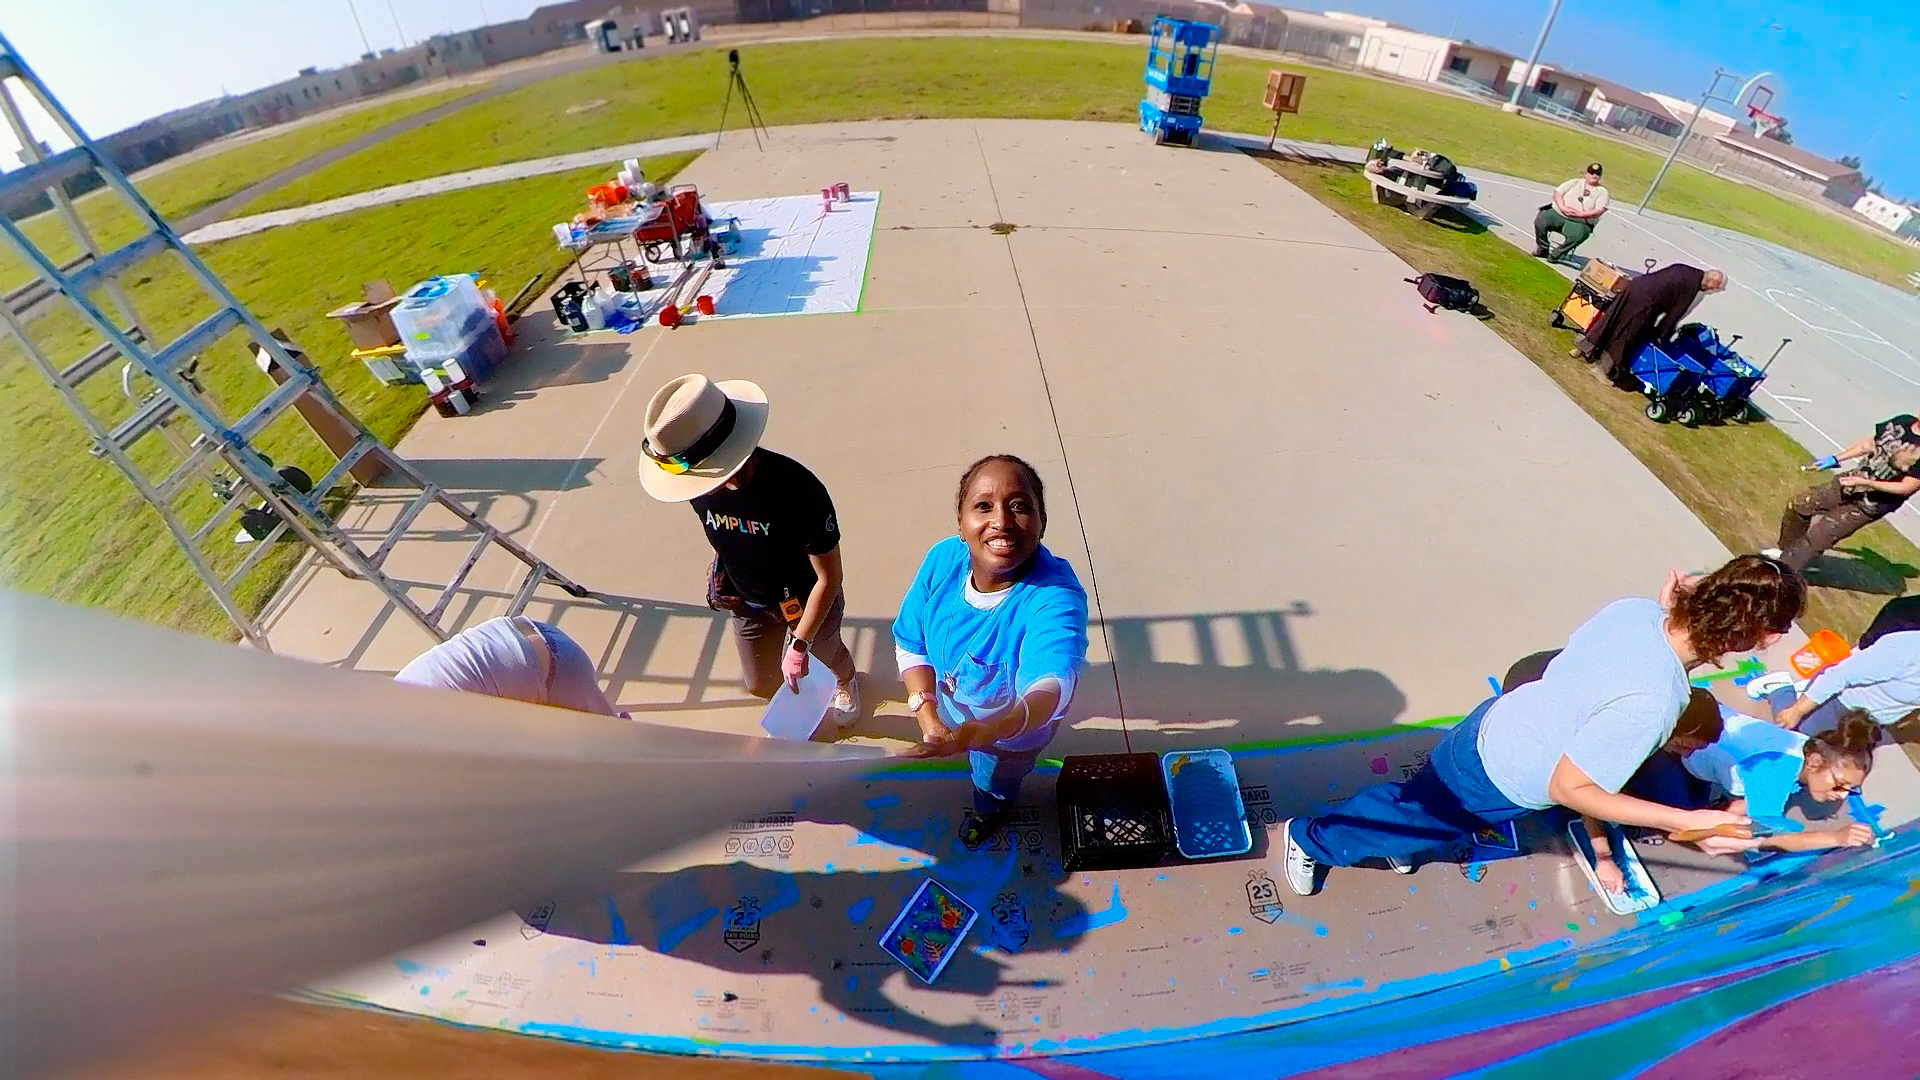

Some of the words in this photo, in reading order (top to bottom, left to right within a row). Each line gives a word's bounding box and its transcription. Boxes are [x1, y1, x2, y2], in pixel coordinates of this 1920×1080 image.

[705, 509, 771, 536] AMPLIFY
[1241, 789, 1270, 801] OARD
[759, 815, 795, 828] BOARD
[1252, 884, 1273, 900] 25
[531, 906, 550, 919] 25
[734, 911, 755, 926] 25
[998, 909, 1020, 926] 25
